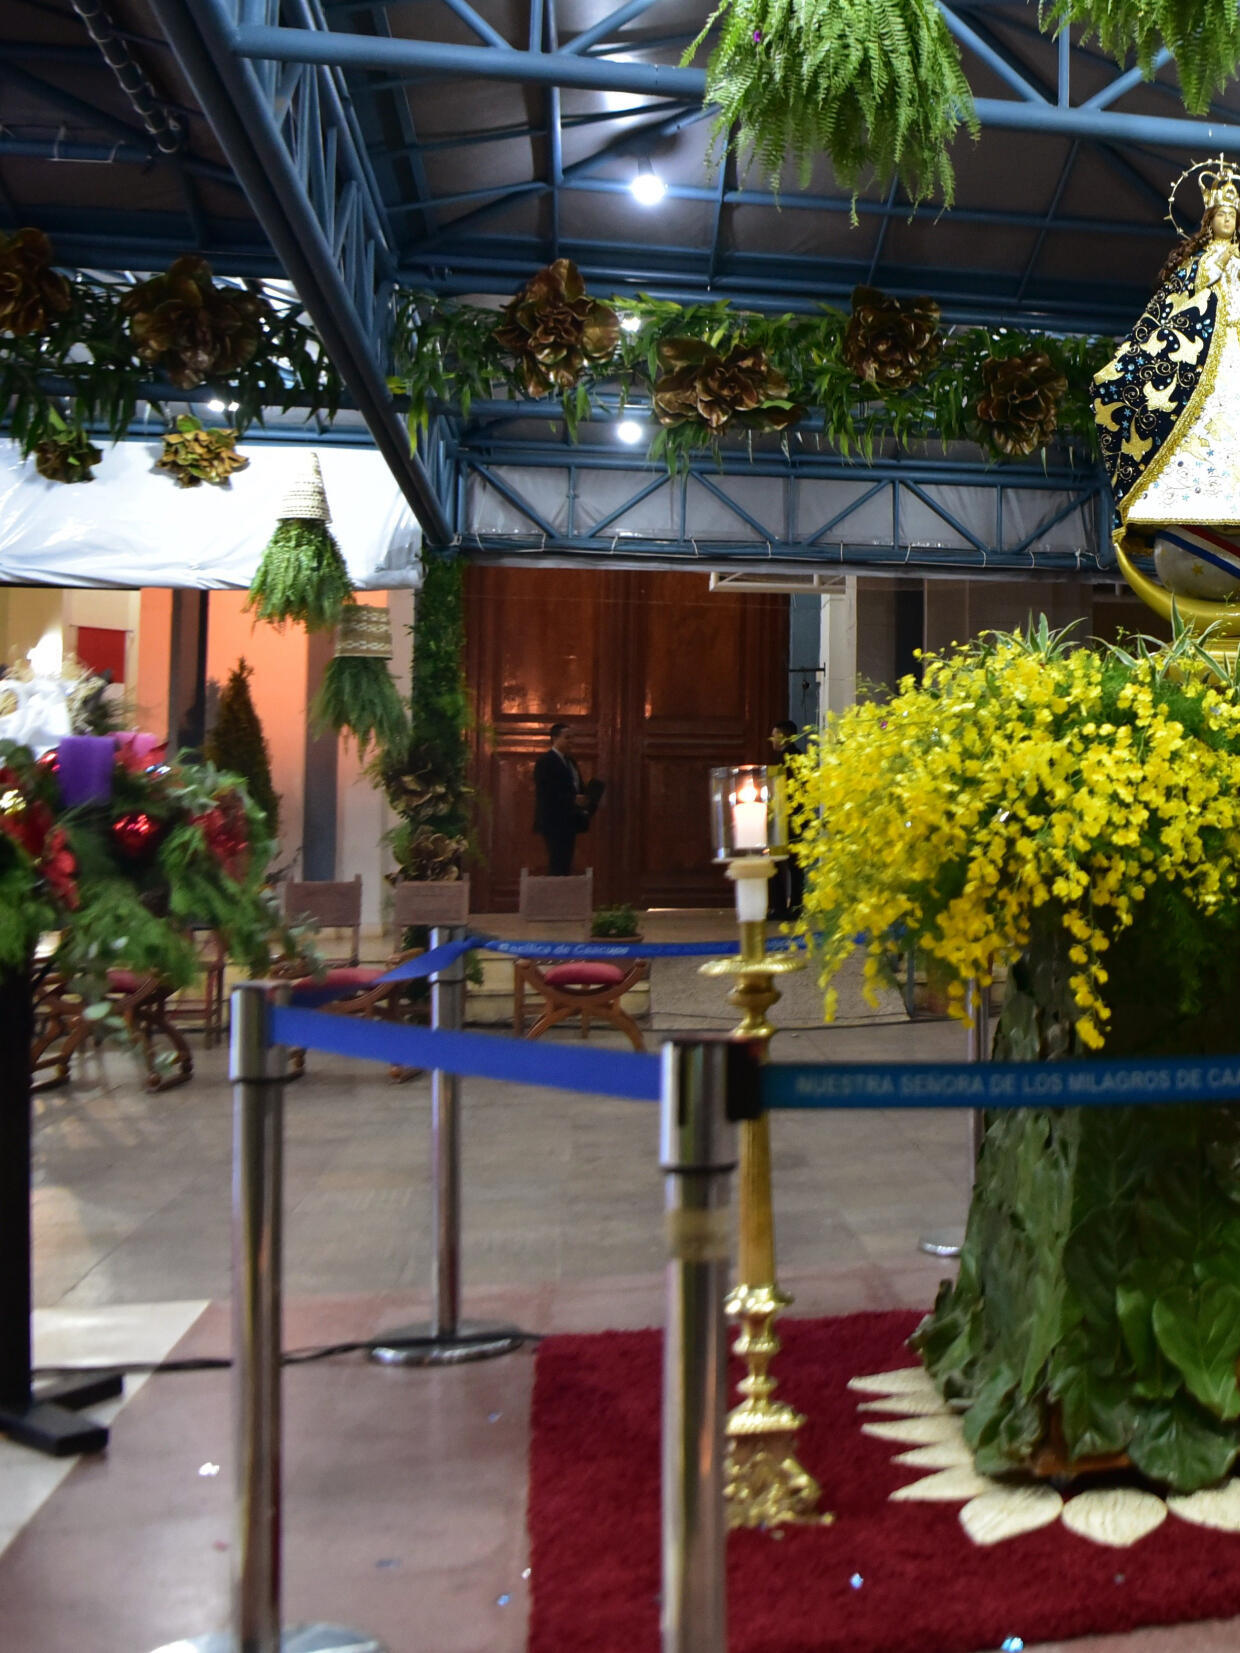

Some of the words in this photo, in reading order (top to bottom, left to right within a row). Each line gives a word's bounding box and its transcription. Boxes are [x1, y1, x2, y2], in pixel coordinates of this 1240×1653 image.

[796, 1072, 895, 1096] NUESTRA
[991, 1072, 1017, 1096] DE
[1022, 1071, 1063, 1095] LOS
[1067, 1067, 1171, 1094] MILAGROS
[1175, 1067, 1203, 1090] DE
